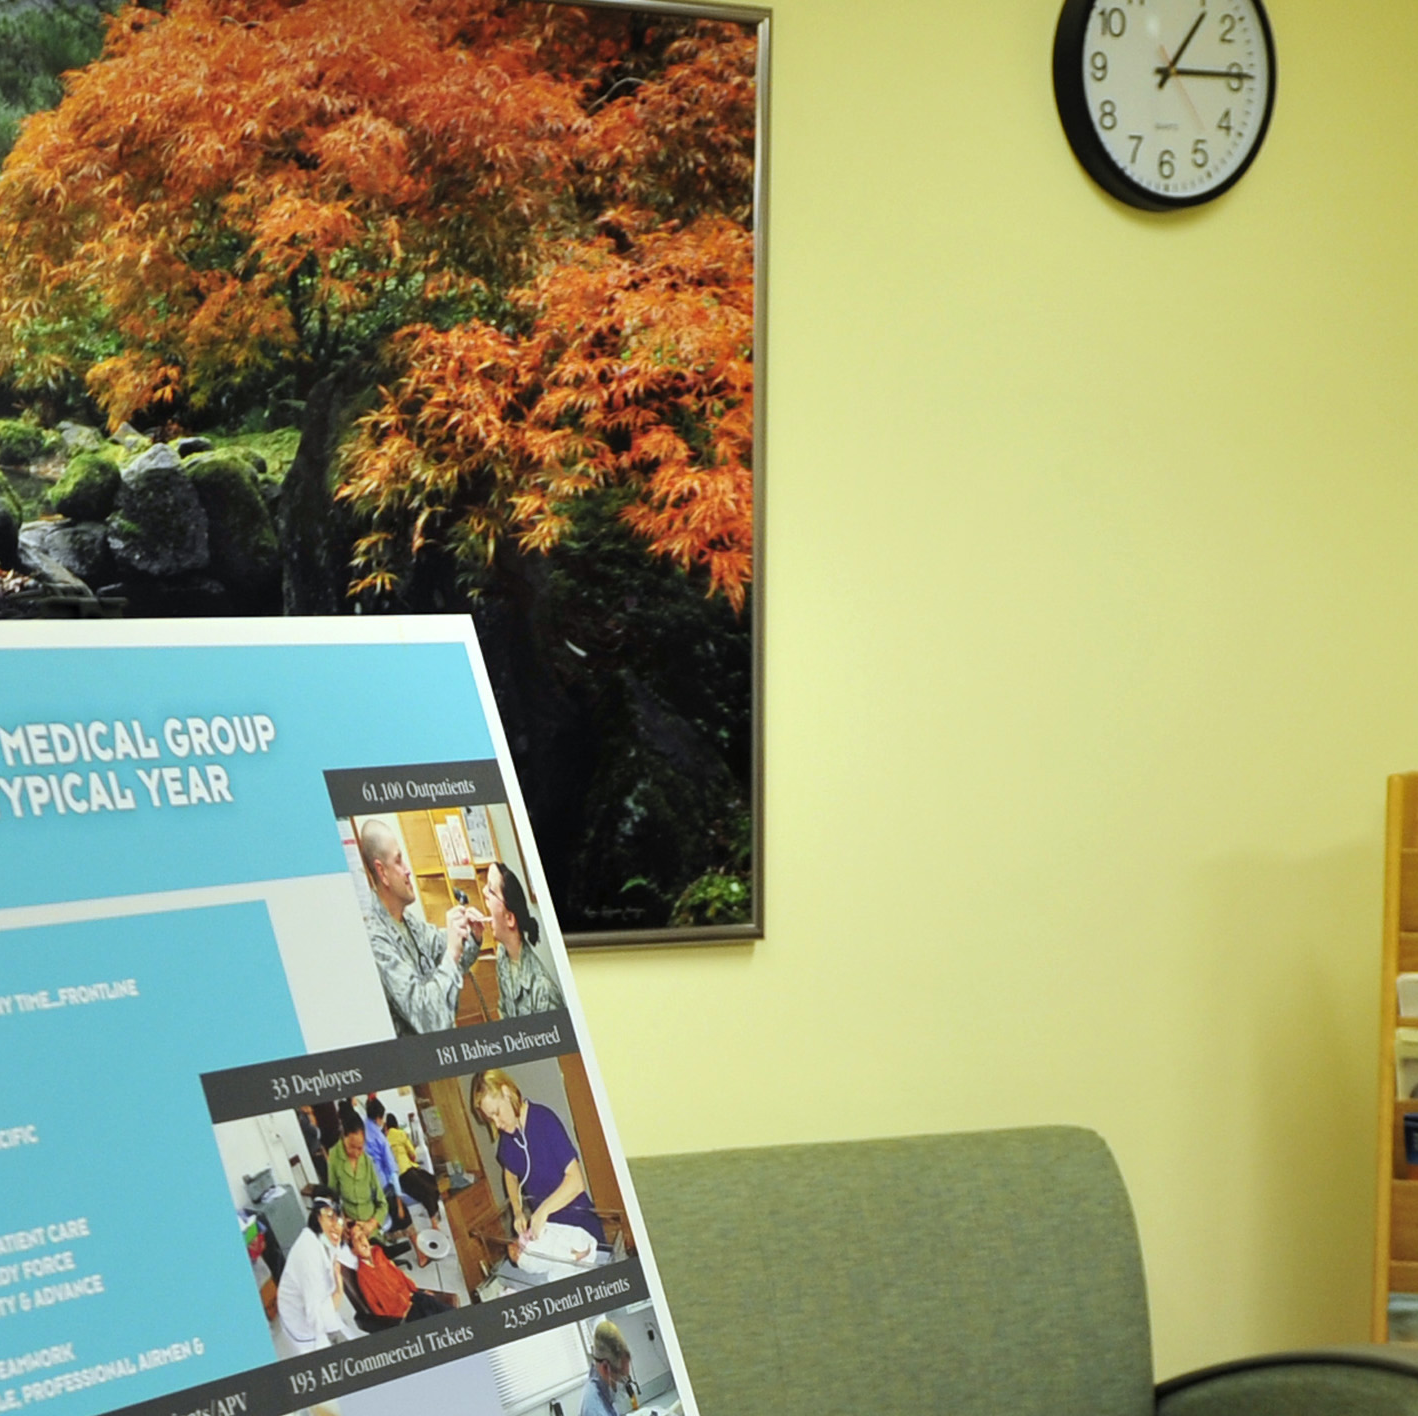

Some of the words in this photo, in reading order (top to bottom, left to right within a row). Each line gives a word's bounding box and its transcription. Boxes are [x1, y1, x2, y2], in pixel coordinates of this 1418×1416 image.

[1098, 8, 1126, 37] 10
[1220, 14, 1236, 43] 2
[1091, 52, 1107, 81] 9
[1099, 100, 1117, 130] 8
[1217, 109, 1231, 136] 4
[1129, 135, 1144, 164] 7
[1191, 139, 1209, 168] 5
[1159, 150, 1175, 179] 6
[162, 714, 276, 757] GROUP
[136, 764, 234, 808] YEAR
[362, 781, 404, 802] 61,100
[407, 778, 476, 801] Outpatients
[436, 1044, 460, 1066] 181
[461, 1034, 502, 1062] Babies
[504, 1026, 561, 1054] Delivered
[272, 1078, 290, 1100] 33
[292, 1066, 363, 1095] Deployers
[46, 1217, 90, 1245] CARE
[22, 1251, 76, 1278] FORCE
[33, 1274, 105, 1308] ADVANCE
[544, 1288, 584, 1319] Dental
[585, 1277, 630, 1306] Patients
[21, 1357, 136, 1403] PROFESSIONAL
[137, 1340, 191, 1374] AIRMEN
[289, 1370, 317, 1395] 193
[319, 1332, 424, 1385] AE/Commercial
[424, 1323, 473, 1356] Tickets
